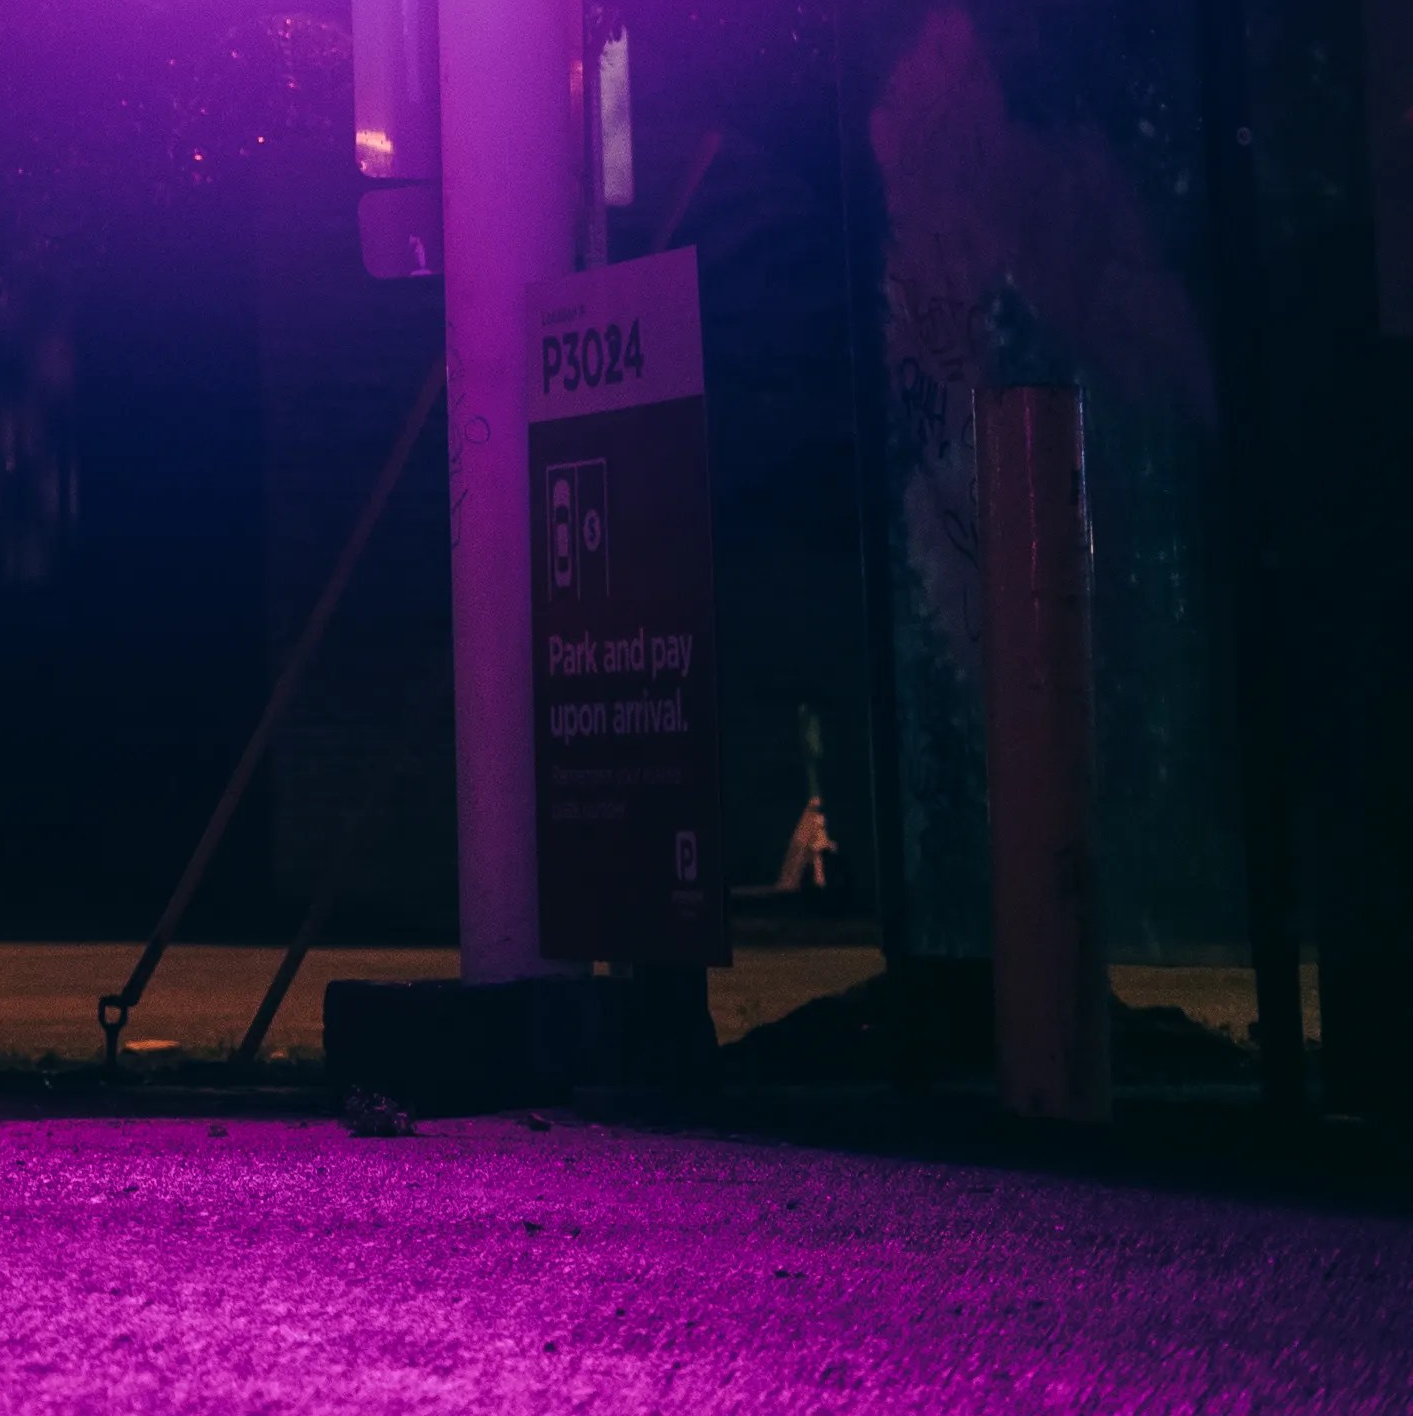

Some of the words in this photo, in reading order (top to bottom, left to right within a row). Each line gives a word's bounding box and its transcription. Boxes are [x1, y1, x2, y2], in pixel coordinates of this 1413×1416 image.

[542, 316, 645, 395] P3024
[547, 630, 599, 677] Park
[602, 626, 646, 674] and
[650, 634, 694, 682] pay
[549, 700, 607, 747] upon
[612, 685, 689, 735] arrival.
